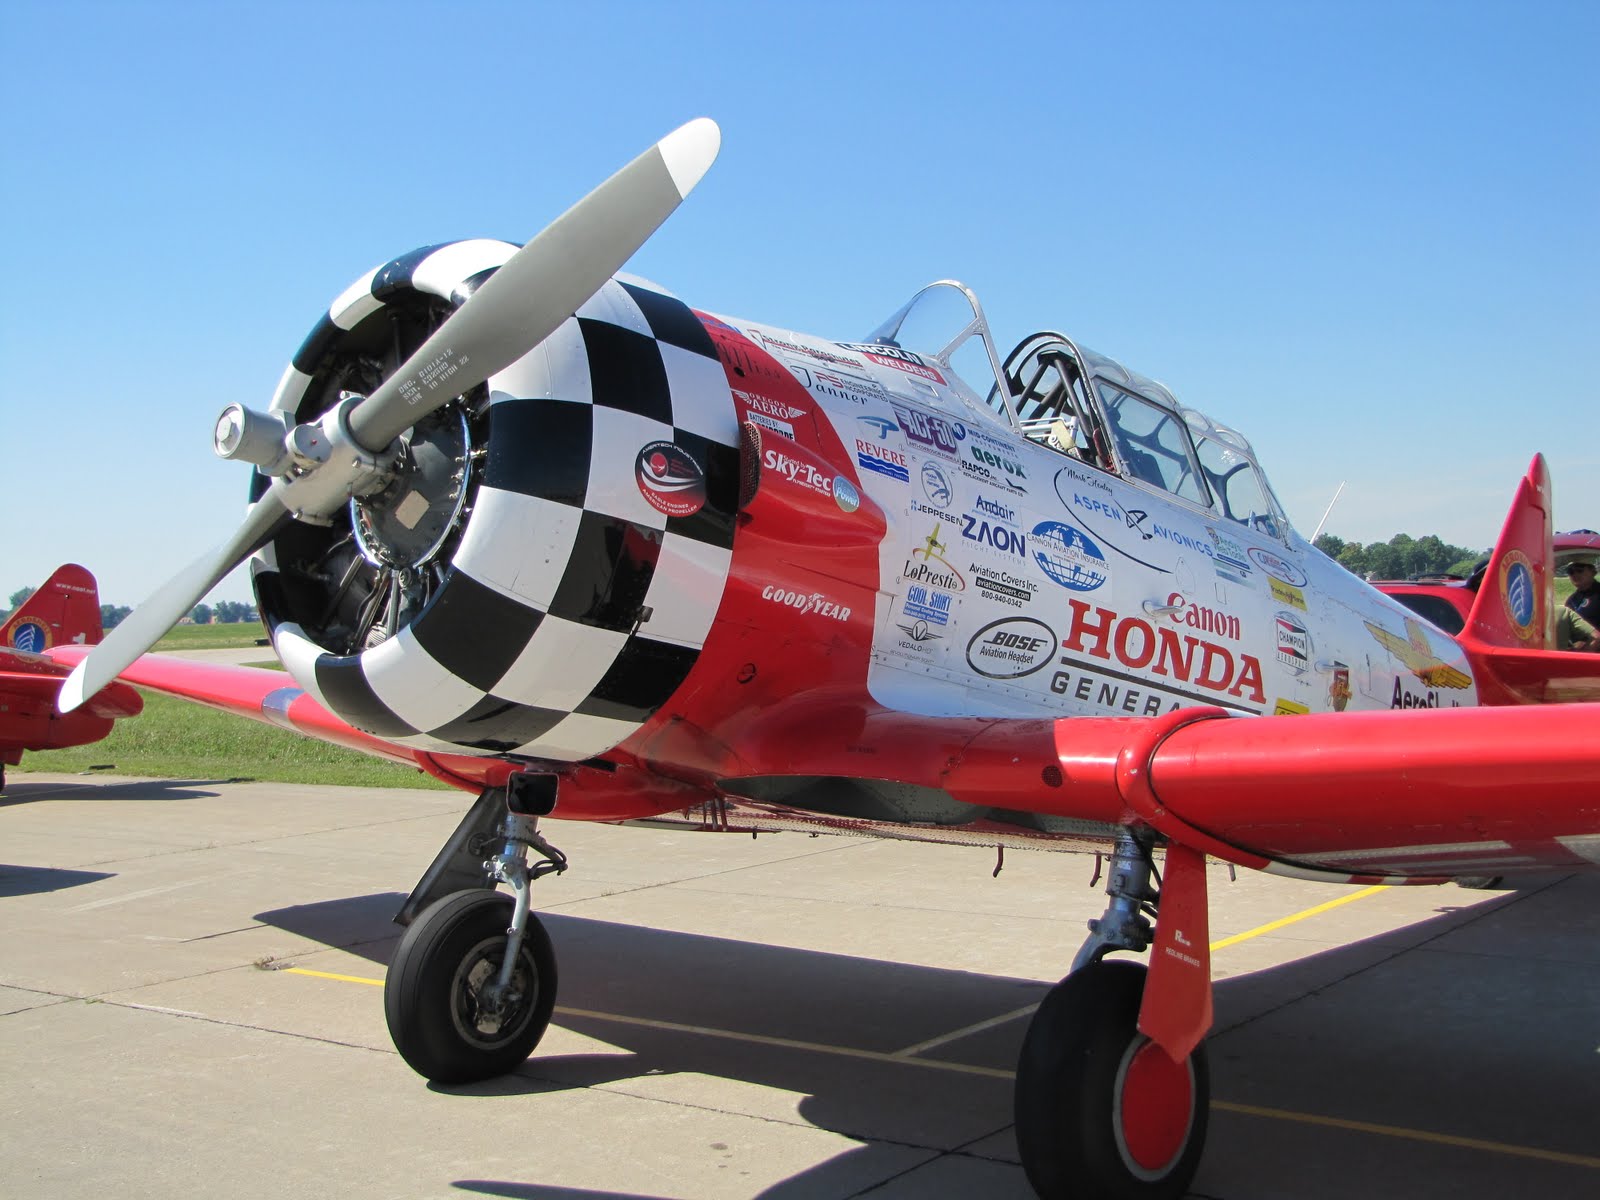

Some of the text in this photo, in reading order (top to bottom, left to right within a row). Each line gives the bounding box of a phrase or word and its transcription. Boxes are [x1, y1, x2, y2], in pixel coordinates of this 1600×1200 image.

[840, 343, 922, 366] LINCOLN
[873, 356, 937, 381] WELDERS
[749, 392, 786, 408] OREGON
[752, 399, 789, 419] AERO
[908, 411, 957, 449] ACF-50
[856, 438, 908, 467] REVERE
[971, 445, 1027, 480] aerox
[764, 449, 832, 491] Sky-Tec
[642, 488, 667, 511] AMERICAN
[651, 492, 667, 505] EAGLE
[976, 495, 1015, 521] Andair
[917, 504, 964, 526] JEPPESEN
[1074, 493, 1121, 521] ASPEN
[1153, 524, 1213, 557] AVIONICS
[1026, 532, 1052, 549] CANNON
[1053, 542, 1080, 560] AVIATION
[1080, 552, 1110, 571] INSURANCE
[903, 560, 954, 589] LoPresti
[969, 563, 1039, 593] Aviation Covers Inc.
[907, 585, 928, 606] COOL
[976, 578, 1031, 601] aviationcovers.com
[981, 590, 1023, 608] 800-940-0342
[762, 585, 851, 621] GOODYEAR
[1167, 592, 1240, 641] Canon
[982, 631, 1048, 653] BOSE
[1061, 598, 1267, 705] HONDA
[1279, 630, 1305, 650] CHAMPION
[980, 646, 1034, 664] Aviation Headset
[1277, 652, 1309, 670] AEROSPACE
